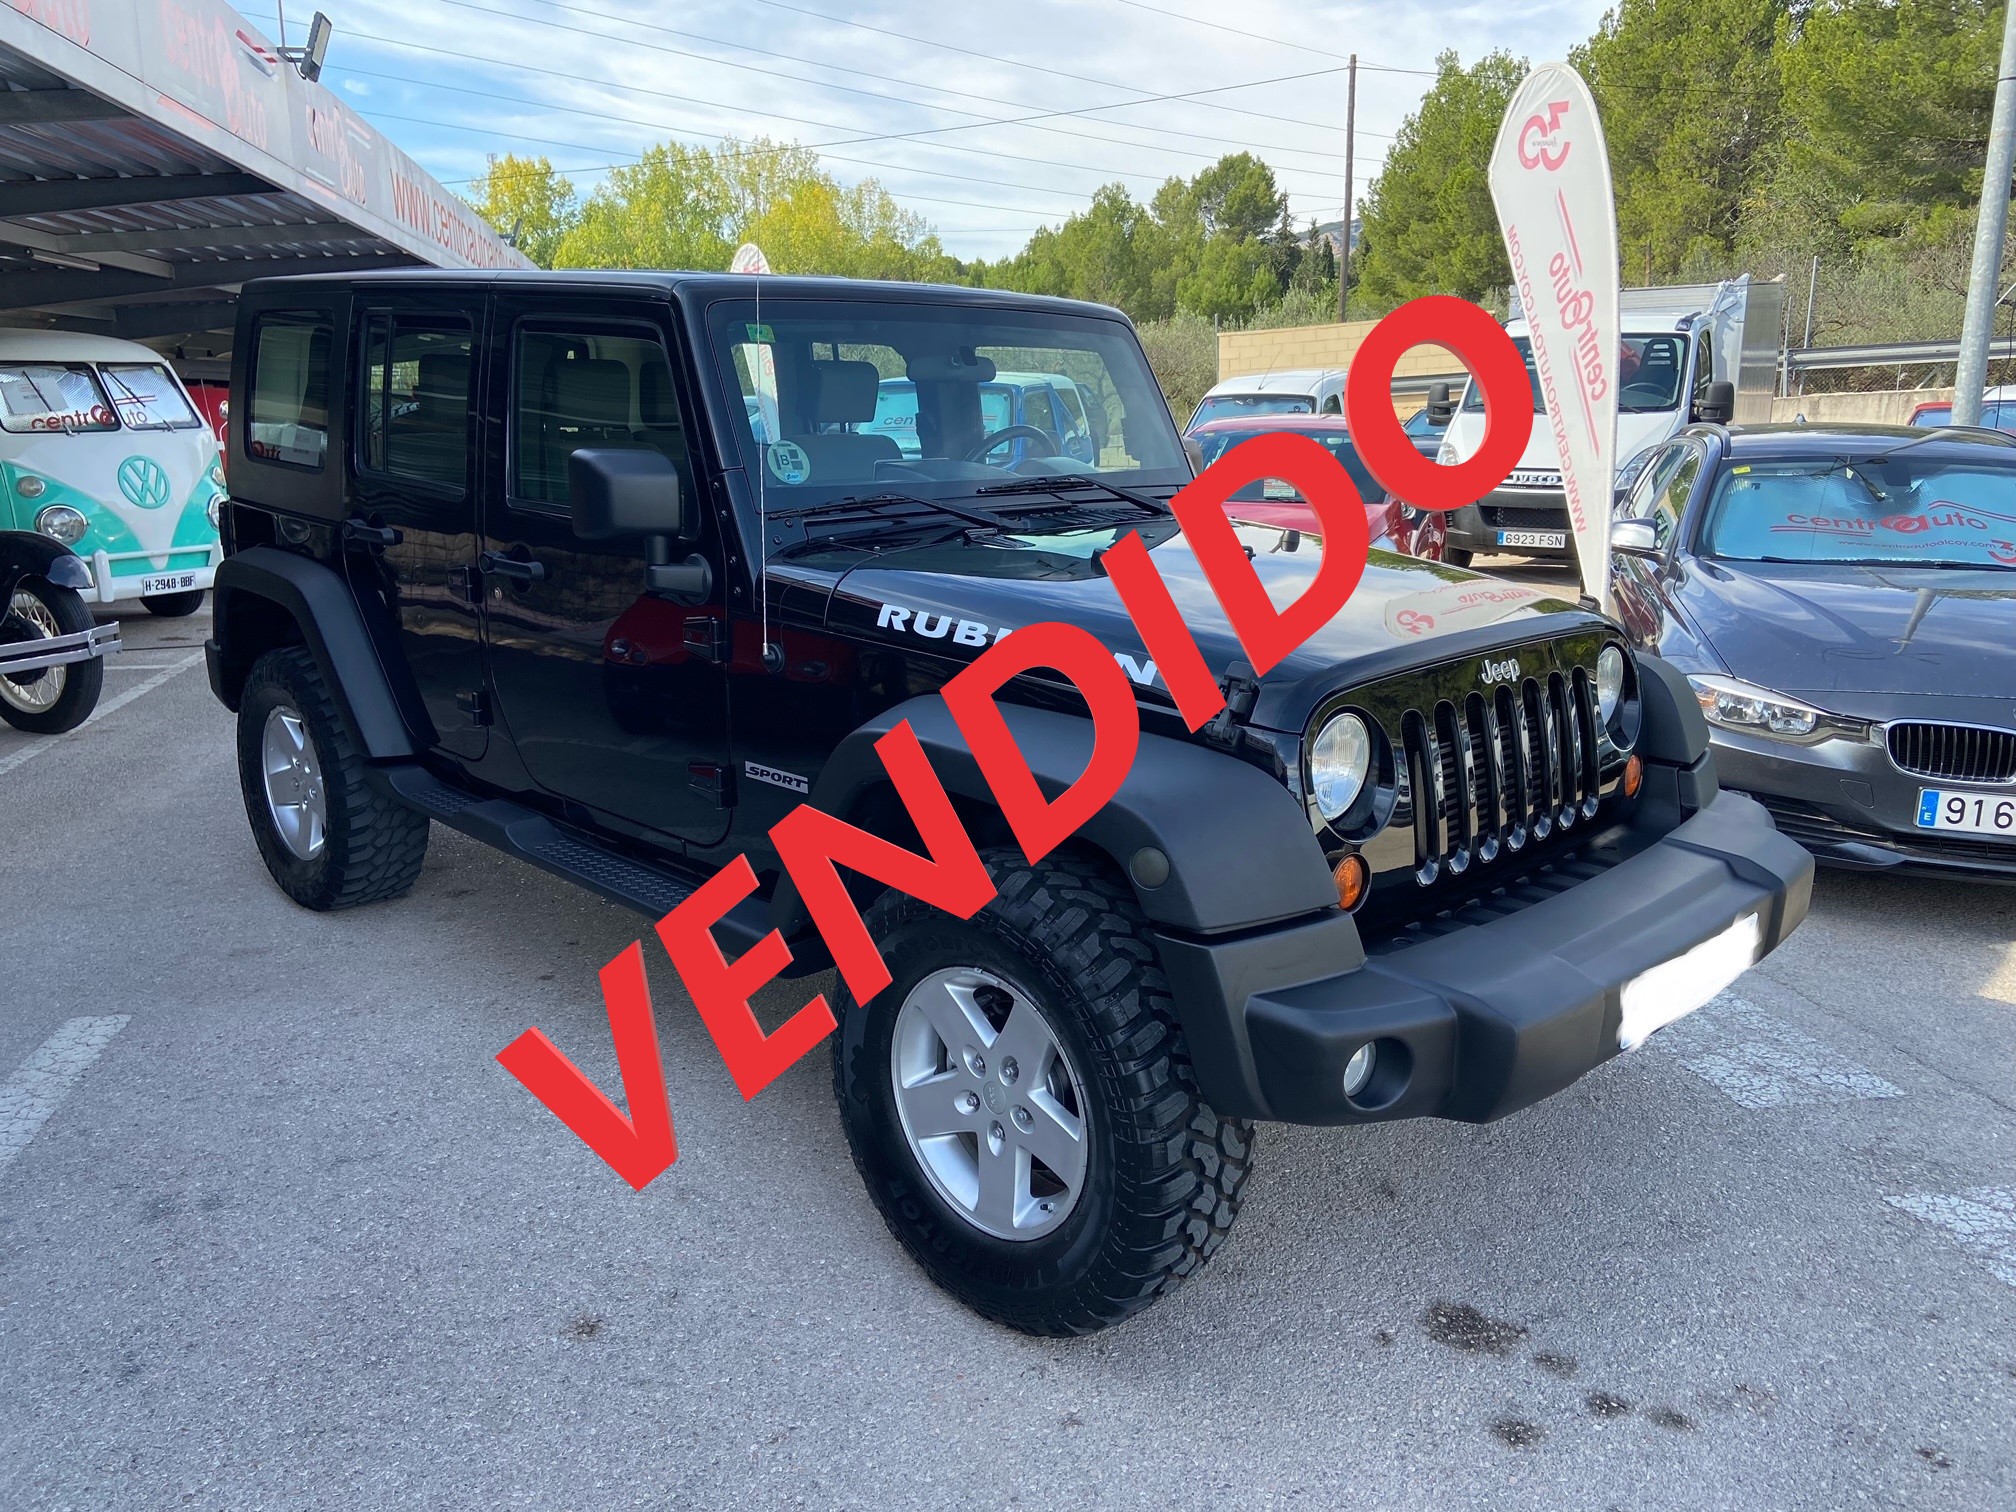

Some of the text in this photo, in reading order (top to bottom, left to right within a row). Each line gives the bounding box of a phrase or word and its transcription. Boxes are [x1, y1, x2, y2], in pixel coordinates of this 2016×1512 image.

[1512, 474, 1558, 485] IVECO
[1505, 533, 1563, 546] 6923 FSN
[876, 603, 1158, 686] RUBN
[1478, 657, 1521, 684] Jeep
[749, 766, 804, 788] SPORT
